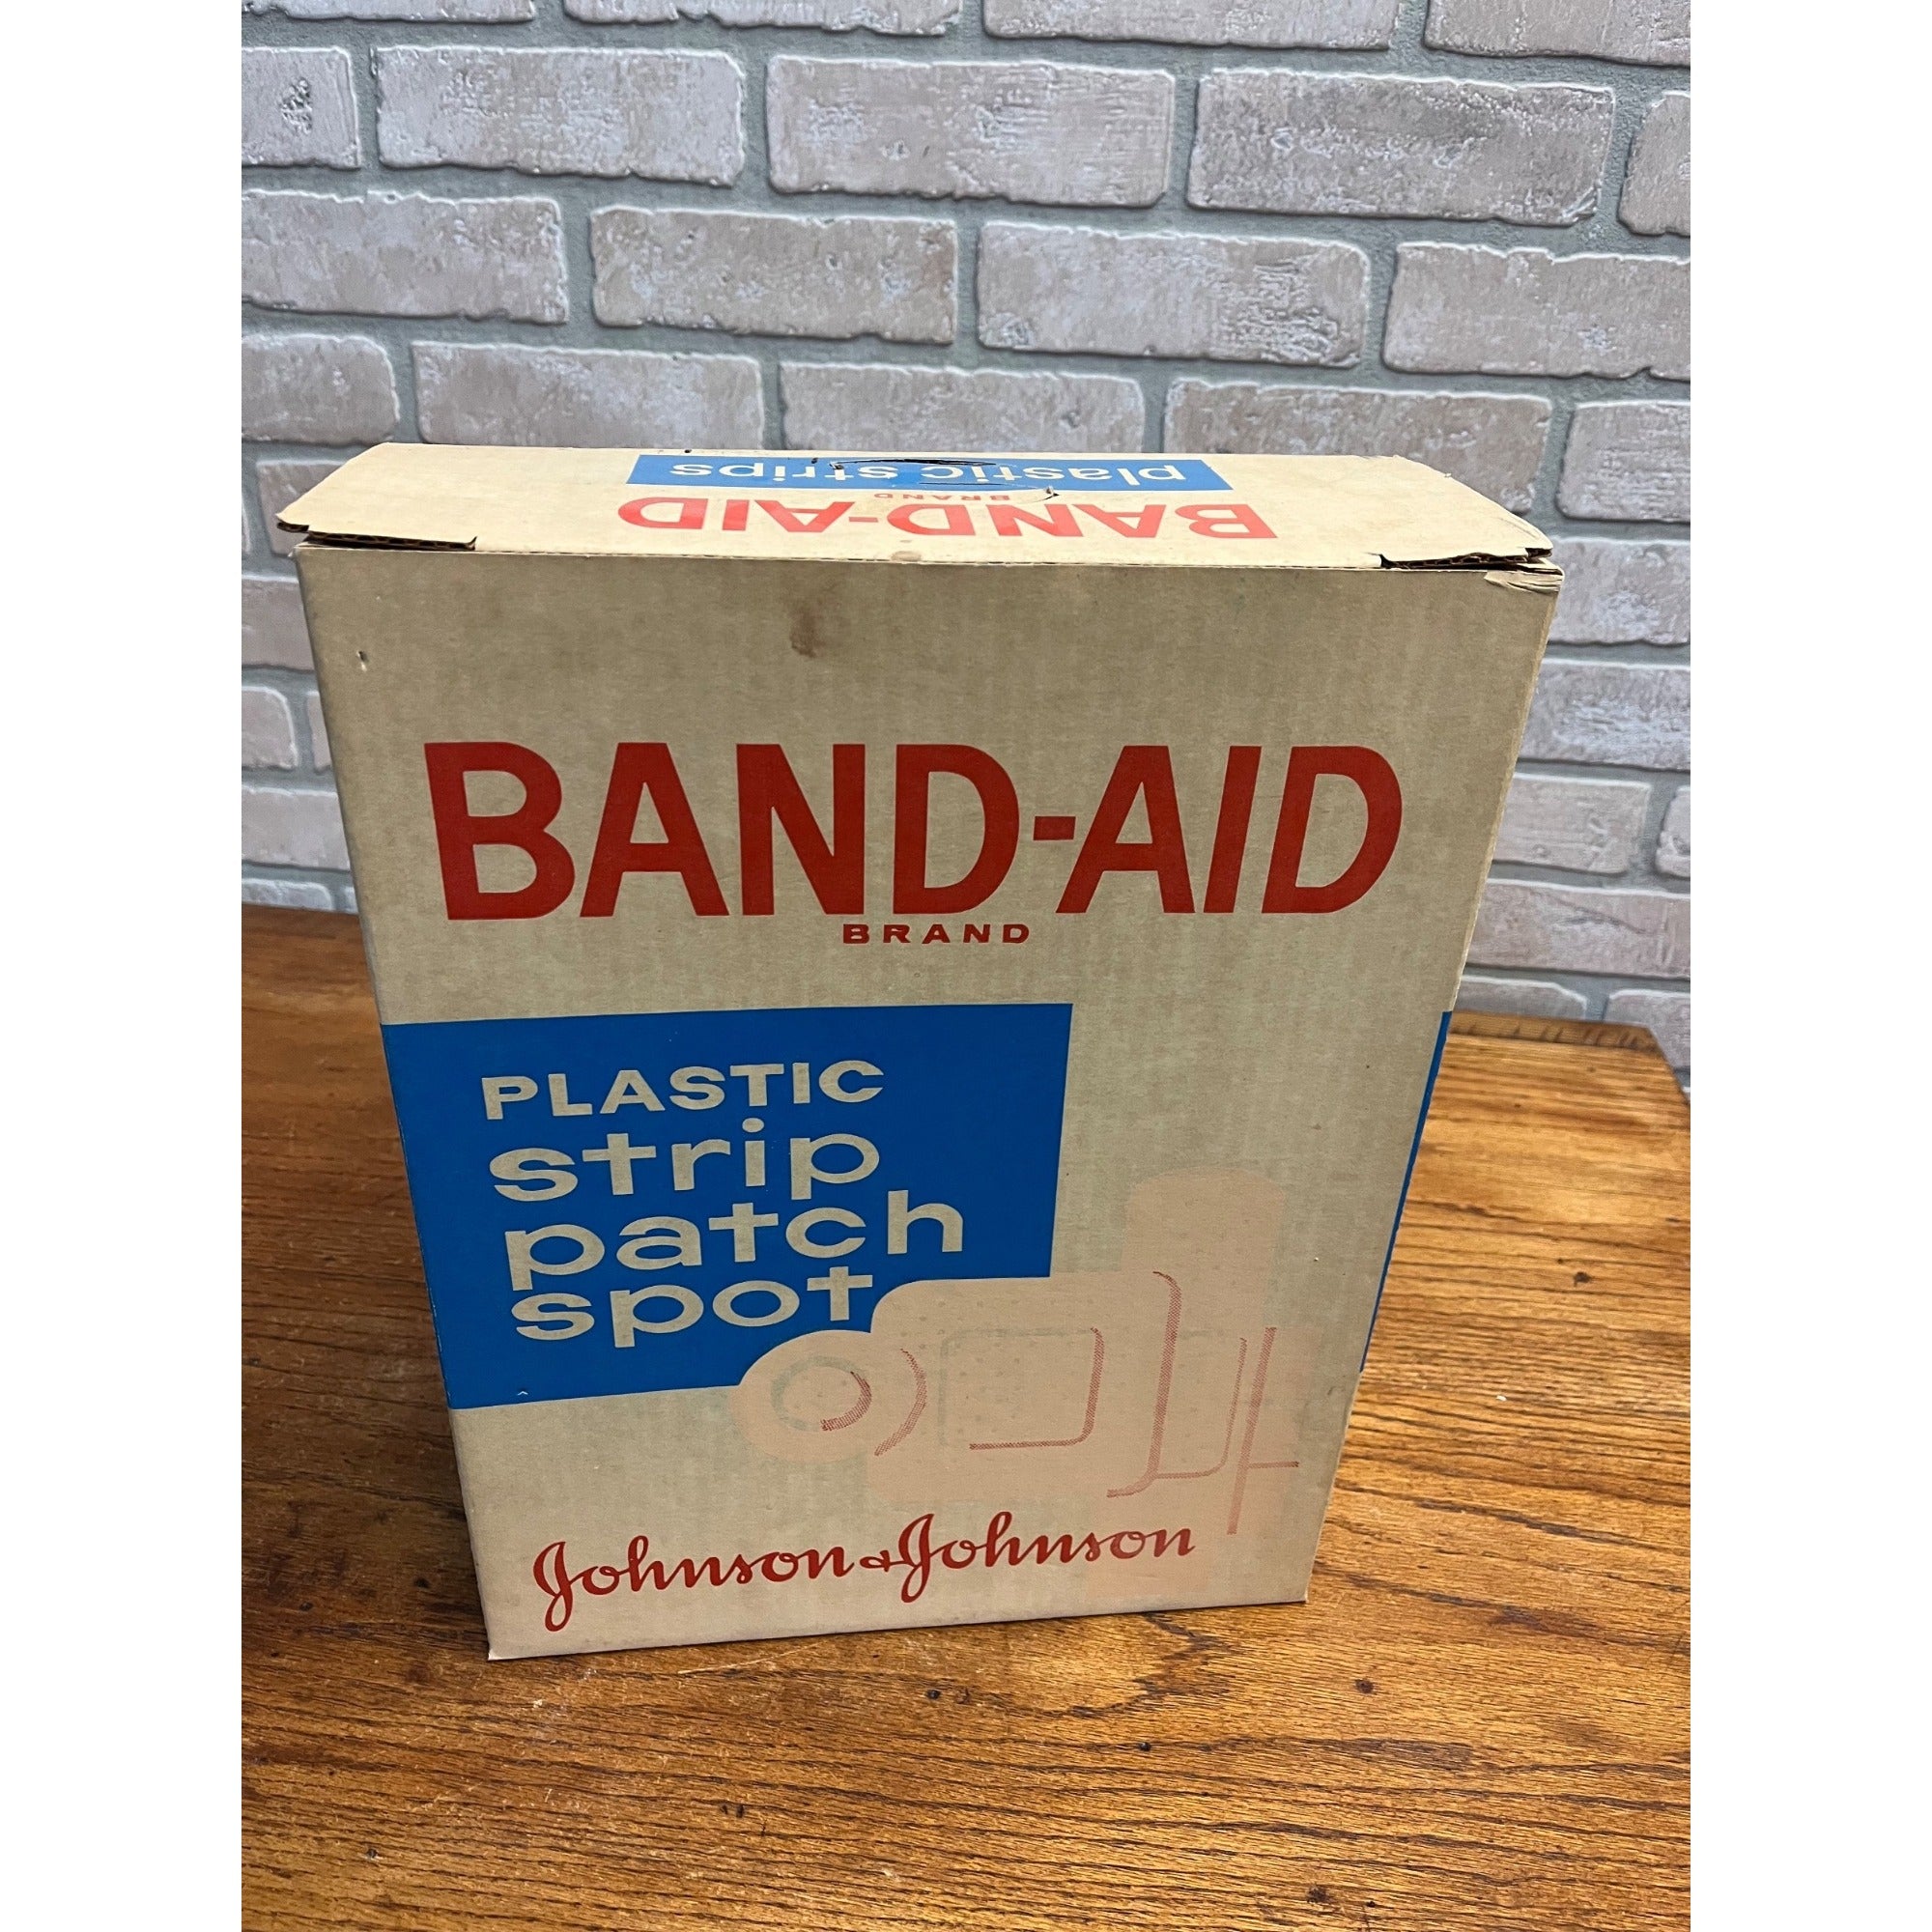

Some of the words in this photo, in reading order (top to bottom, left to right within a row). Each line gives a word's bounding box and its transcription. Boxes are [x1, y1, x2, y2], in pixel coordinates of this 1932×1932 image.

[669, 462, 898, 482] strips
[873, 492, 1010, 501] BRAND
[920, 464, 1187, 486] plastic
[617, 497, 1279, 539] BAND-AID
[424, 742, 1404, 921] BAND-AID
[841, 923, 1031, 946] BRAND
[481, 1060, 885, 1121] PLASTIC
[489, 1118, 880, 1202] strip
[504, 1189, 964, 1292] patch
[510, 1265, 873, 1349] spot
[533, 1534, 854, 1633] Johnson
[896, 1511, 1196, 1604] Johnson
